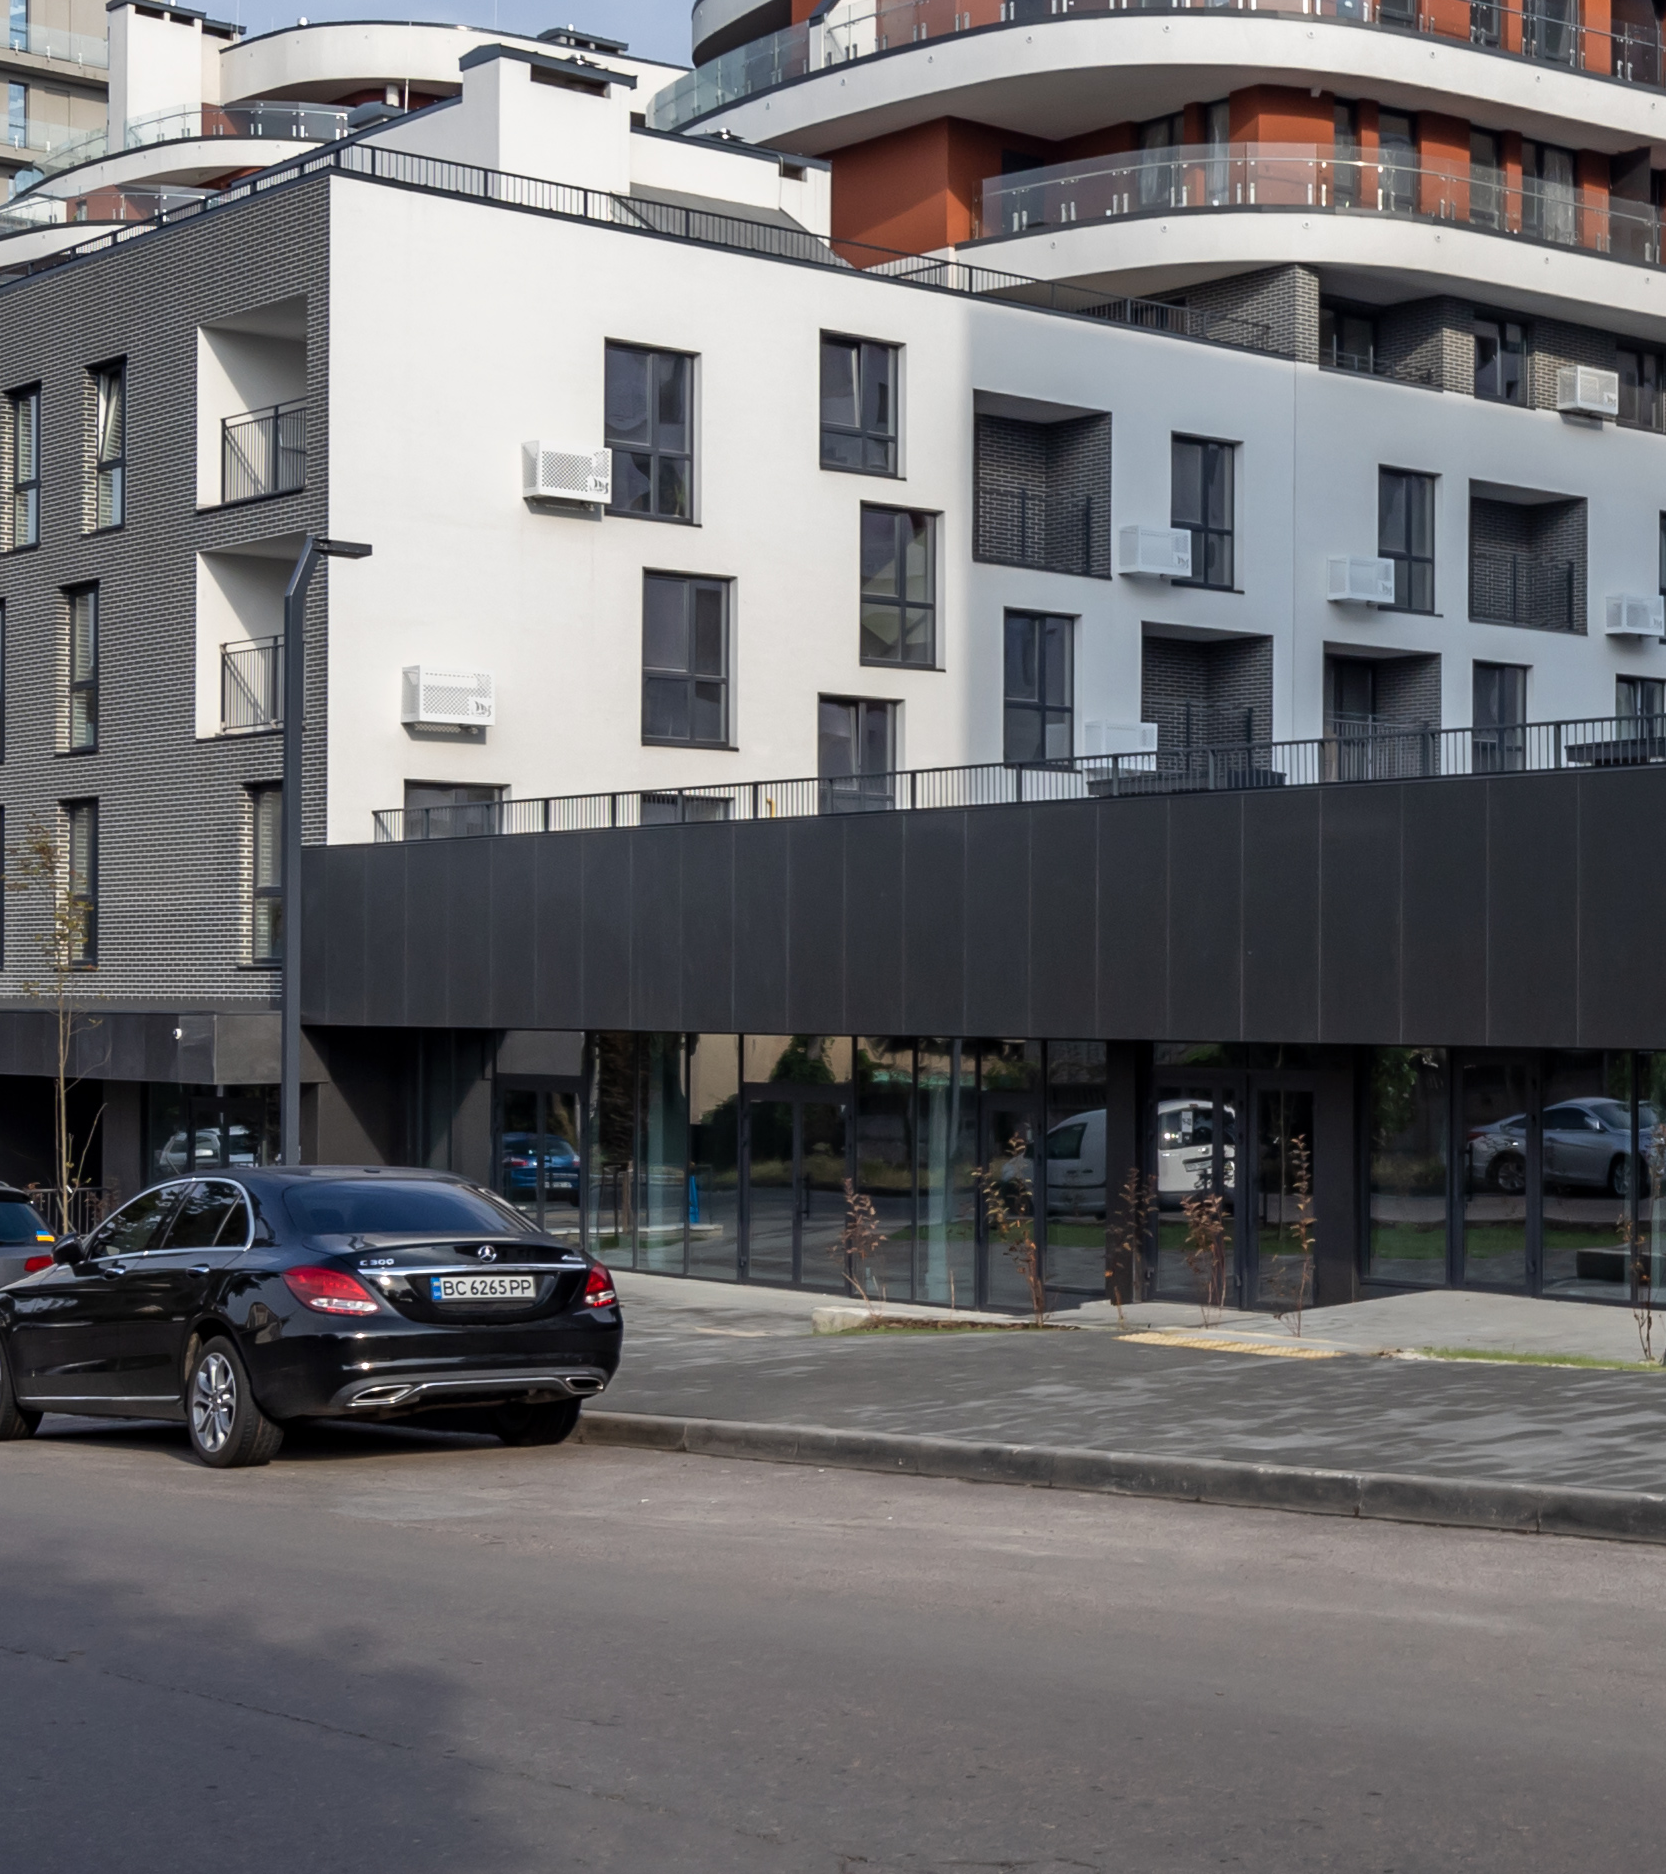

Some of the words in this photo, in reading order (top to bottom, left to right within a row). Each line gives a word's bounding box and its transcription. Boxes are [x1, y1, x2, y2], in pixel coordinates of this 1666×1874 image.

[369, 1258, 395, 1266] 300
[443, 1280, 467, 1296] BC
[470, 1279, 508, 1295] 6265
[509, 1279, 532, 1295] PP
